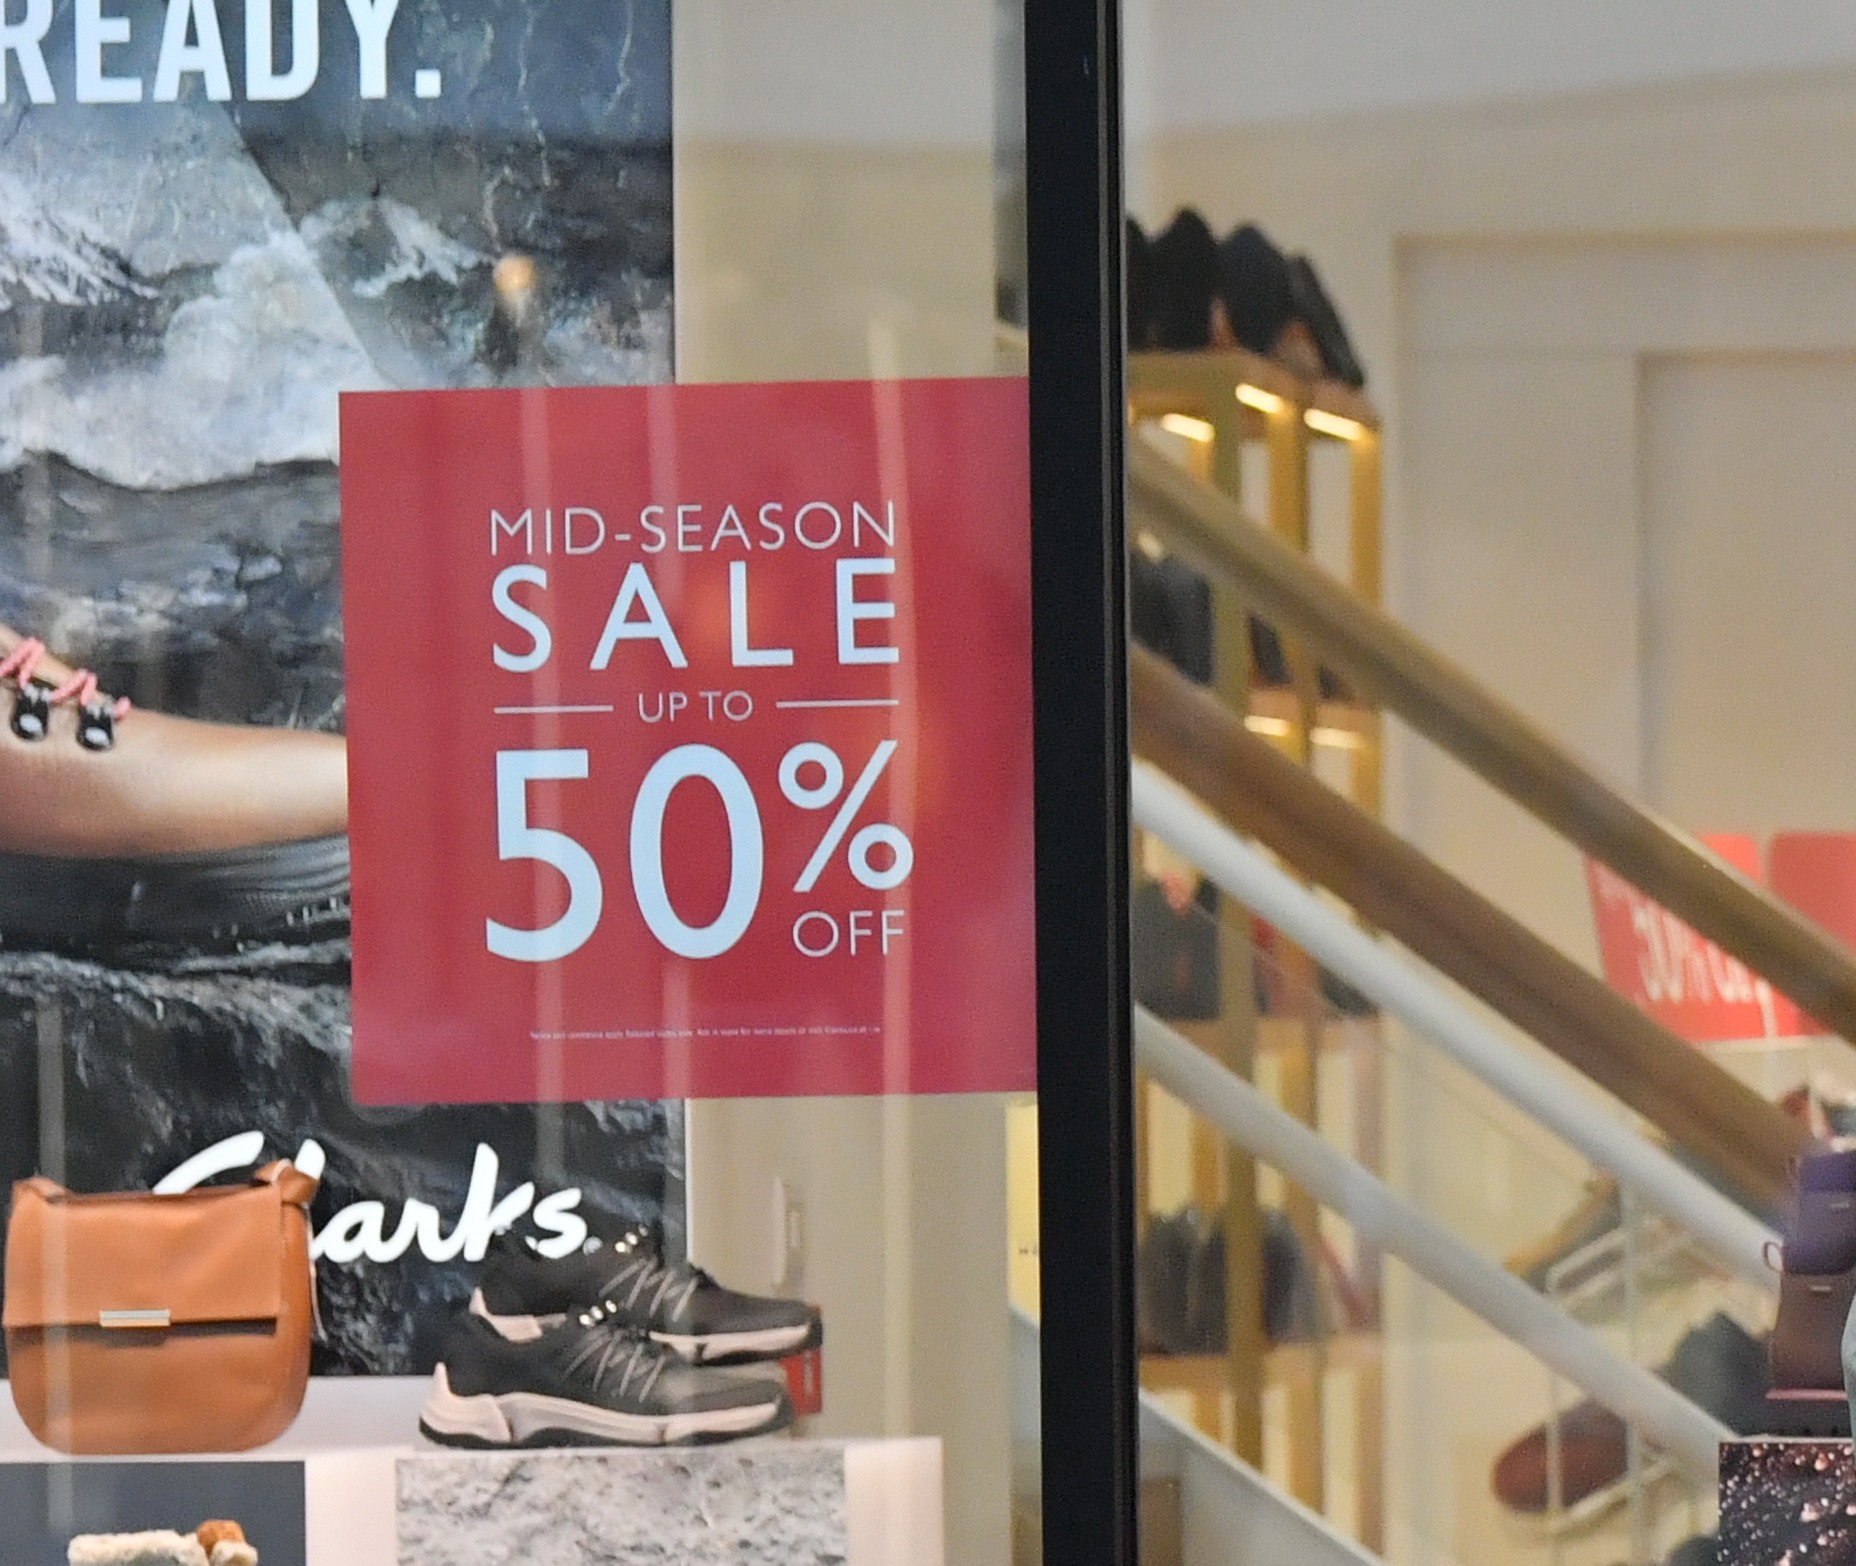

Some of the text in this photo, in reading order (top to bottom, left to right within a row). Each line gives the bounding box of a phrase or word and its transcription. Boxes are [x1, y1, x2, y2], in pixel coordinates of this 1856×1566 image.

[0, 0, 441, 104] READY.
[490, 501, 895, 556] MID-SEASON
[491, 557, 899, 673] SALE
[638, 690, 754, 723] UP TO
[486, 739, 914, 962] 50%
[792, 910, 904, 958] OFF
